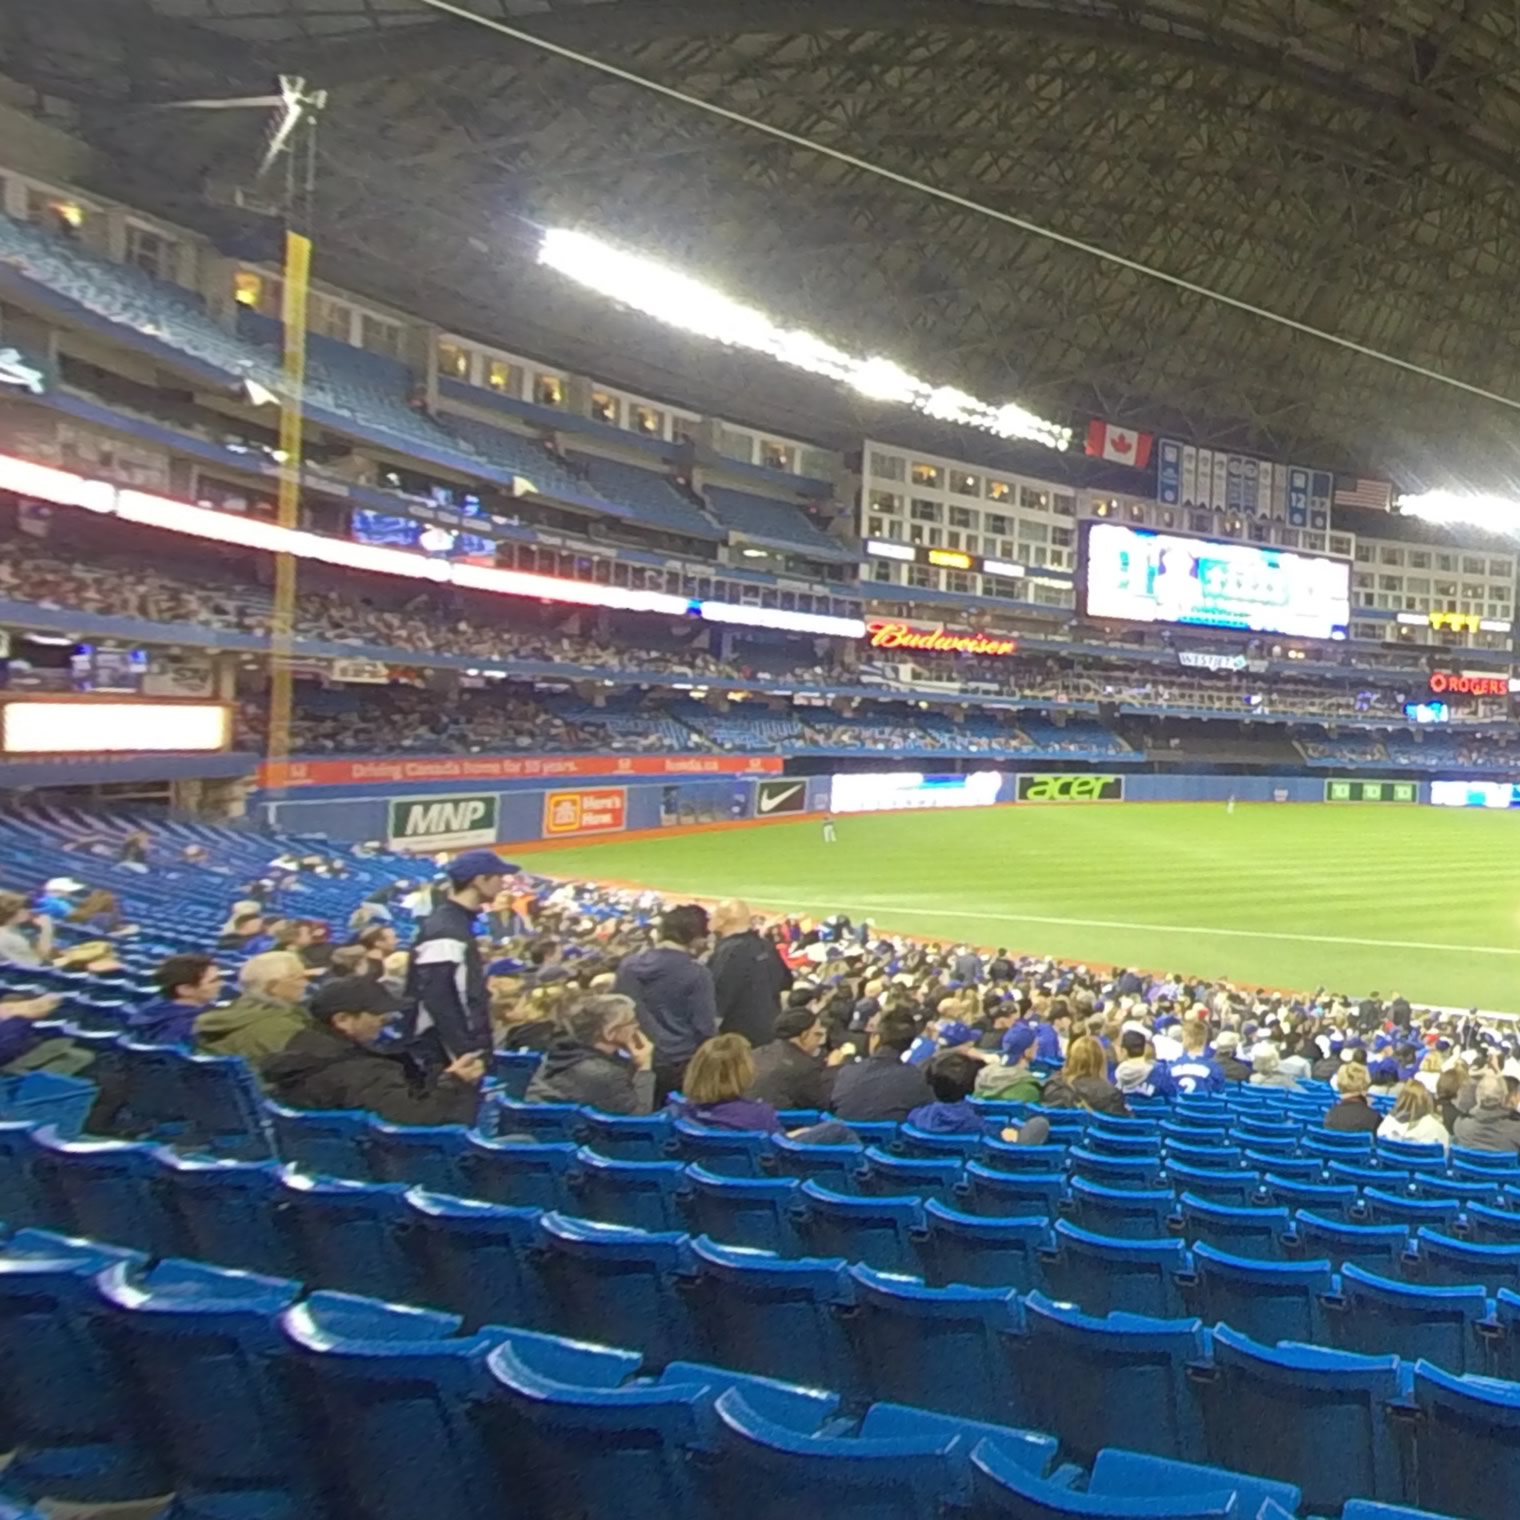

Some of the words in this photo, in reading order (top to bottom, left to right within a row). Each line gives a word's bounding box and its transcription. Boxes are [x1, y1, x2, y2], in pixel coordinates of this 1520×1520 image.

[1291, 492, 1306, 509] 12
[866, 622, 1017, 655] Budweiser
[1449, 676, 1507, 695] ROGERS
[405, 762, 460, 776] Canada
[1027, 776, 1115, 800] acer
[405, 801, 485, 835] MNP
